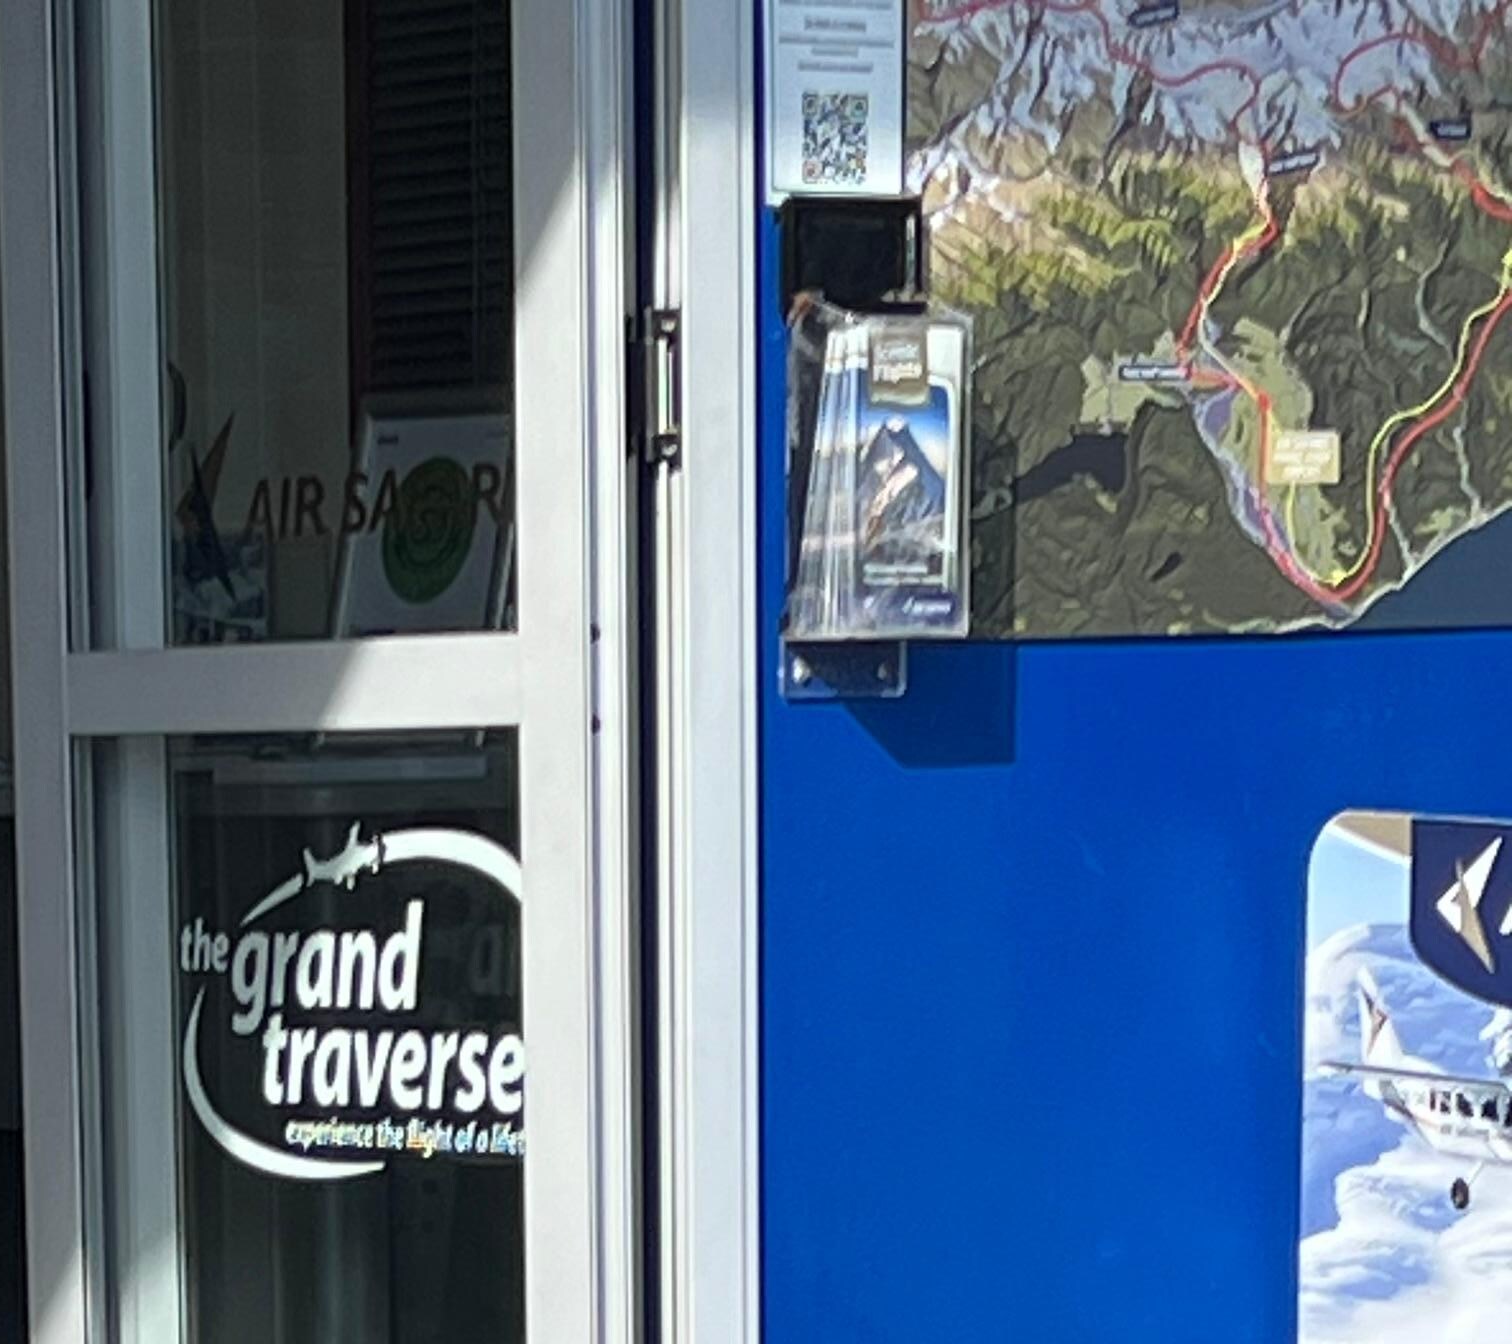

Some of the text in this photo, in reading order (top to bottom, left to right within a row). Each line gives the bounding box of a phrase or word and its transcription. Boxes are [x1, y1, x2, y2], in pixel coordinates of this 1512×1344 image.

[244, 474, 329, 544] AIR
[180, 899, 425, 1036] the grand
[262, 1013, 525, 1114] traverse
[285, 1116, 373, 1151] experience
[376, 1115, 405, 1149] the
[406, 1117, 453, 1158] flight
[455, 1120, 478, 1153] of
[476, 1129, 488, 1153] a
